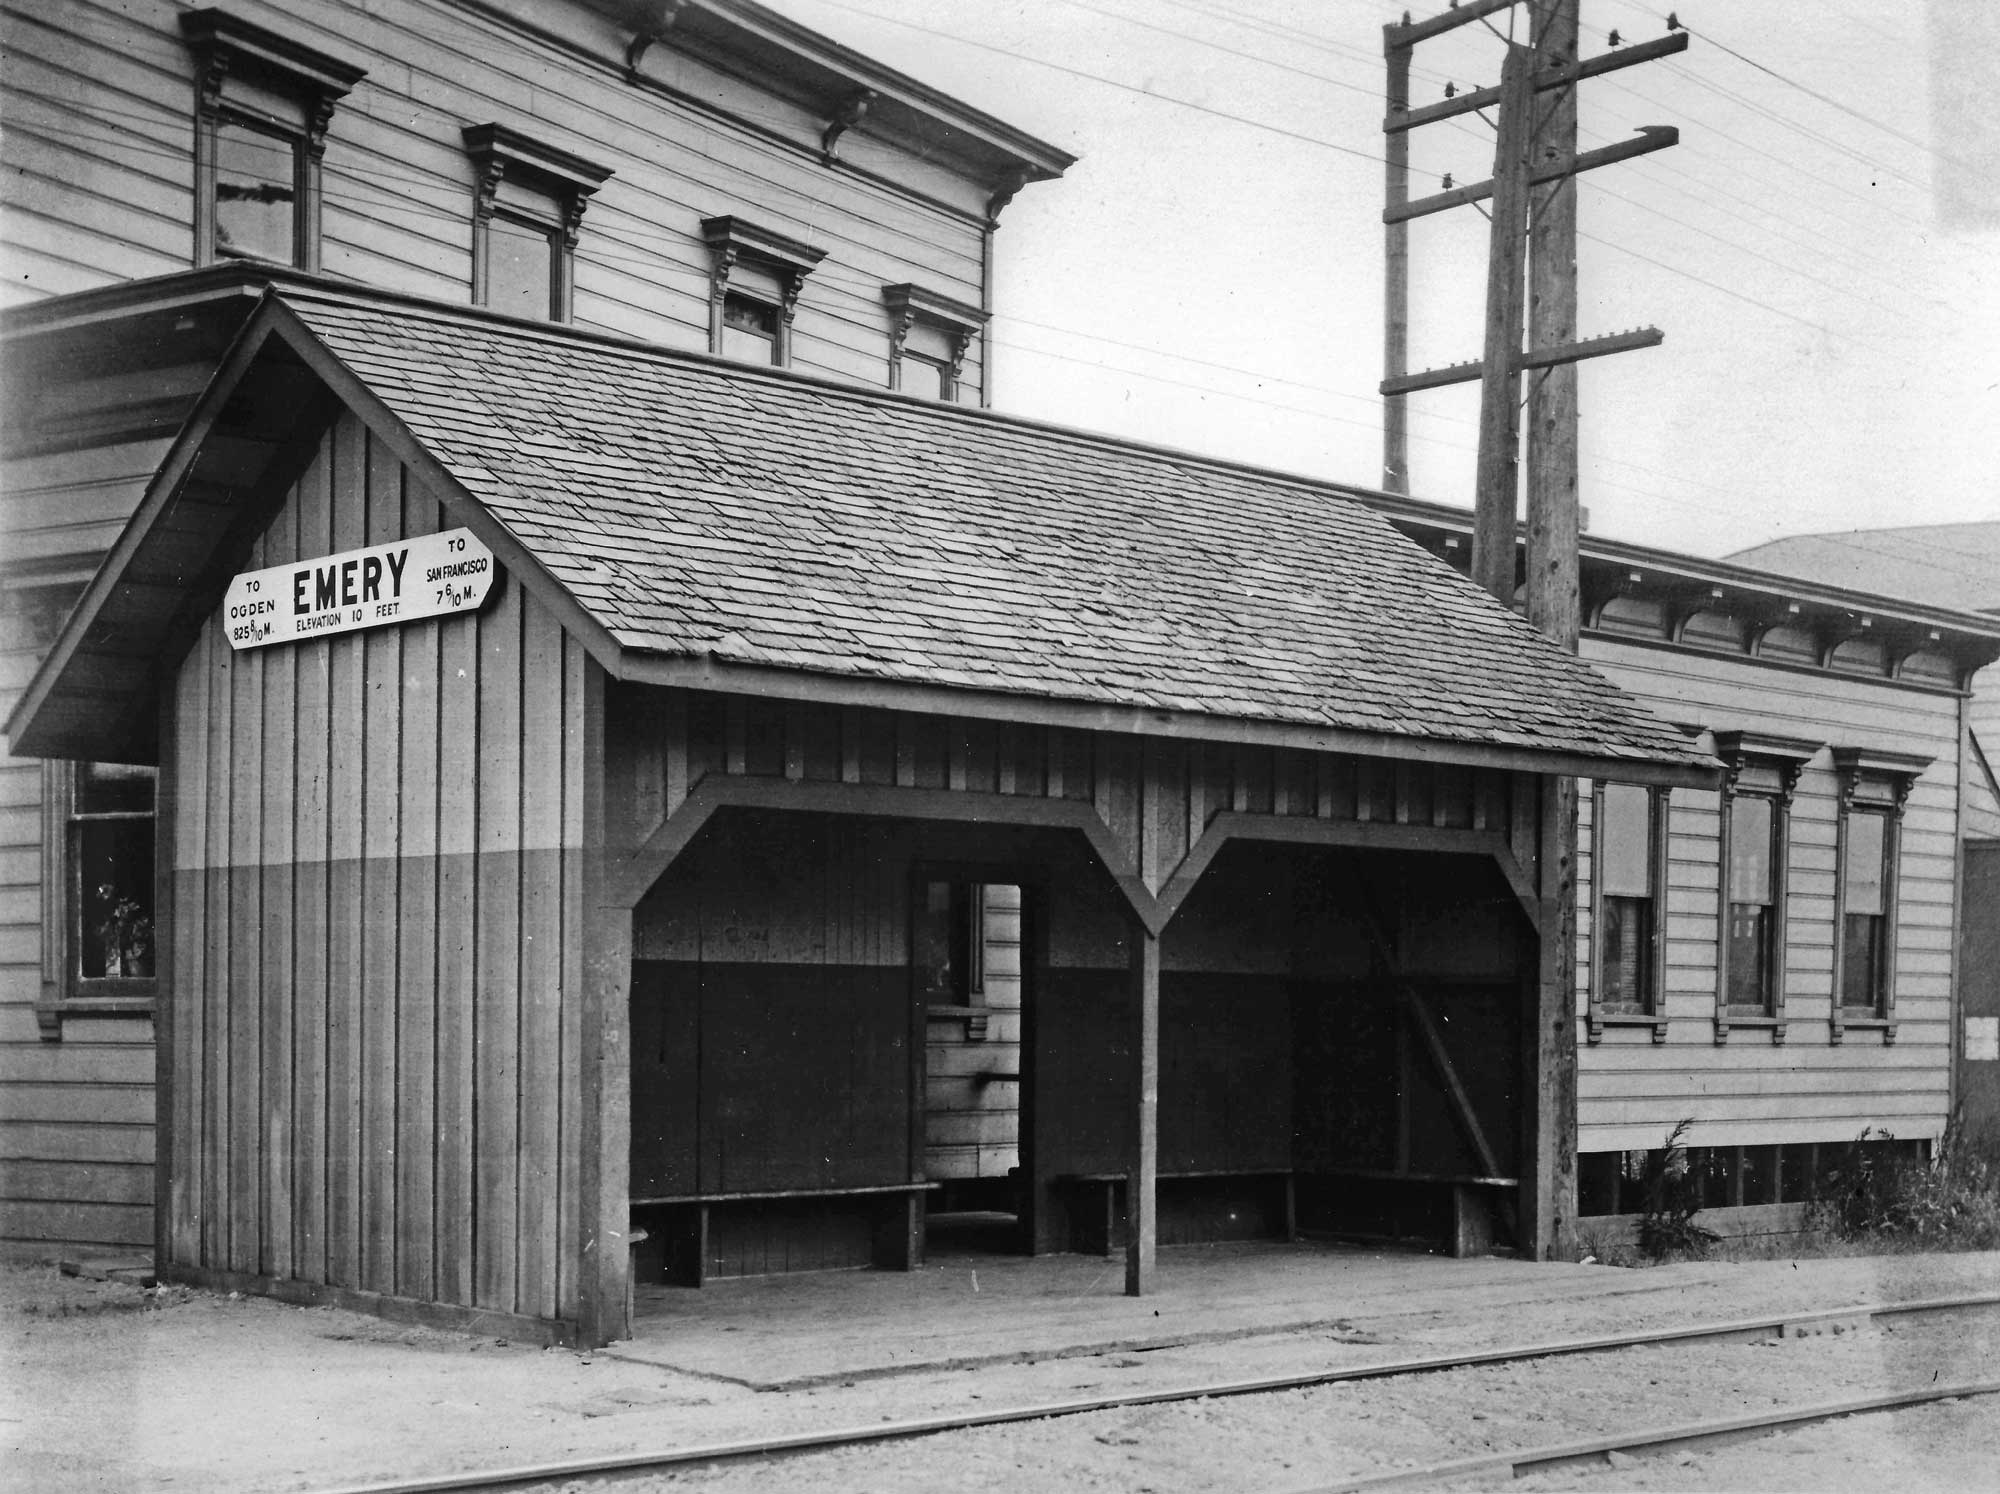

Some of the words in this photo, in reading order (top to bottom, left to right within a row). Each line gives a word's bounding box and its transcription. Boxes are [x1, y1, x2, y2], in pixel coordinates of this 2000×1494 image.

[448, 538, 466, 552] TO
[426, 566, 442, 582] SAN
[443, 558, 488, 579] FRANCISCO
[246, 580, 260, 593] TO
[293, 549, 409, 615] EMERY
[231, 600, 275, 619] OGDEN
[296, 613, 342, 632] ELEVATION
[352, 609, 363, 622] 10
